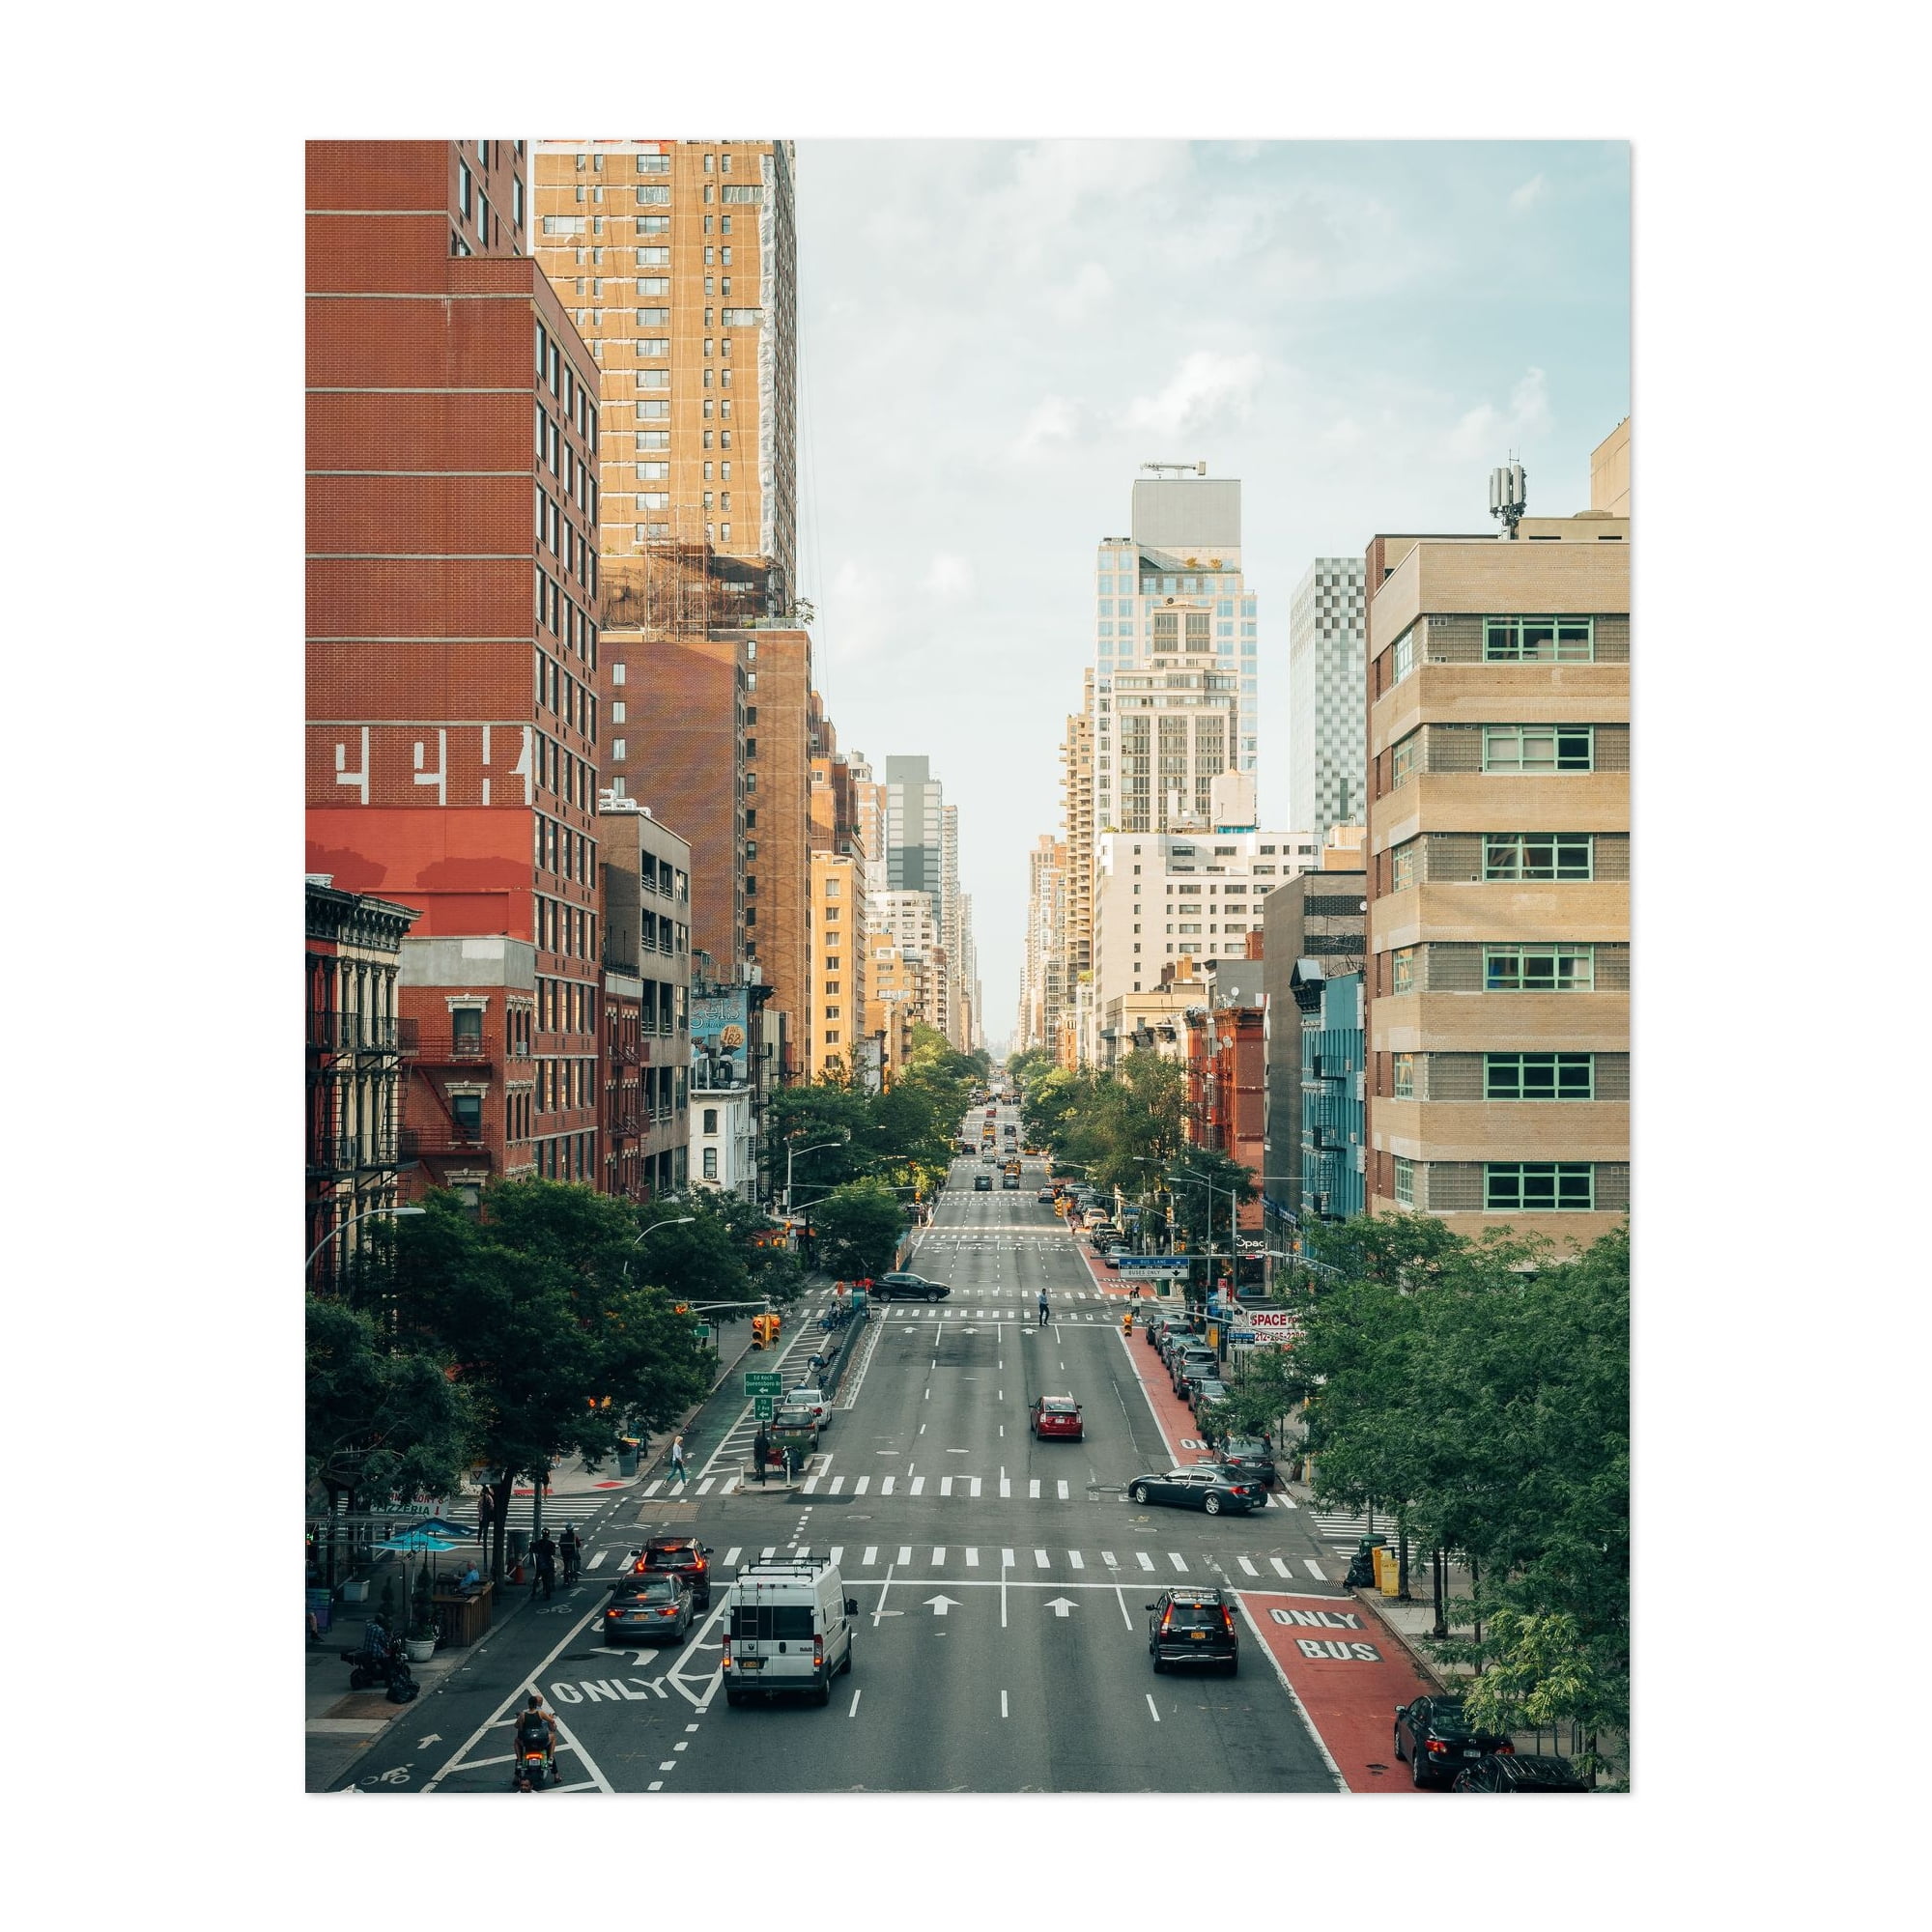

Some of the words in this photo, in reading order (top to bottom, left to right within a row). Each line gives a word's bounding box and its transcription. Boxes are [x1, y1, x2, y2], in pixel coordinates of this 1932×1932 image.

[1250, 1314, 1287, 1326] SPACE
[1269, 1608, 1360, 1630] ONLY
[1295, 1638, 1380, 1662] BUS
[550, 1677, 668, 1704] ONLY
